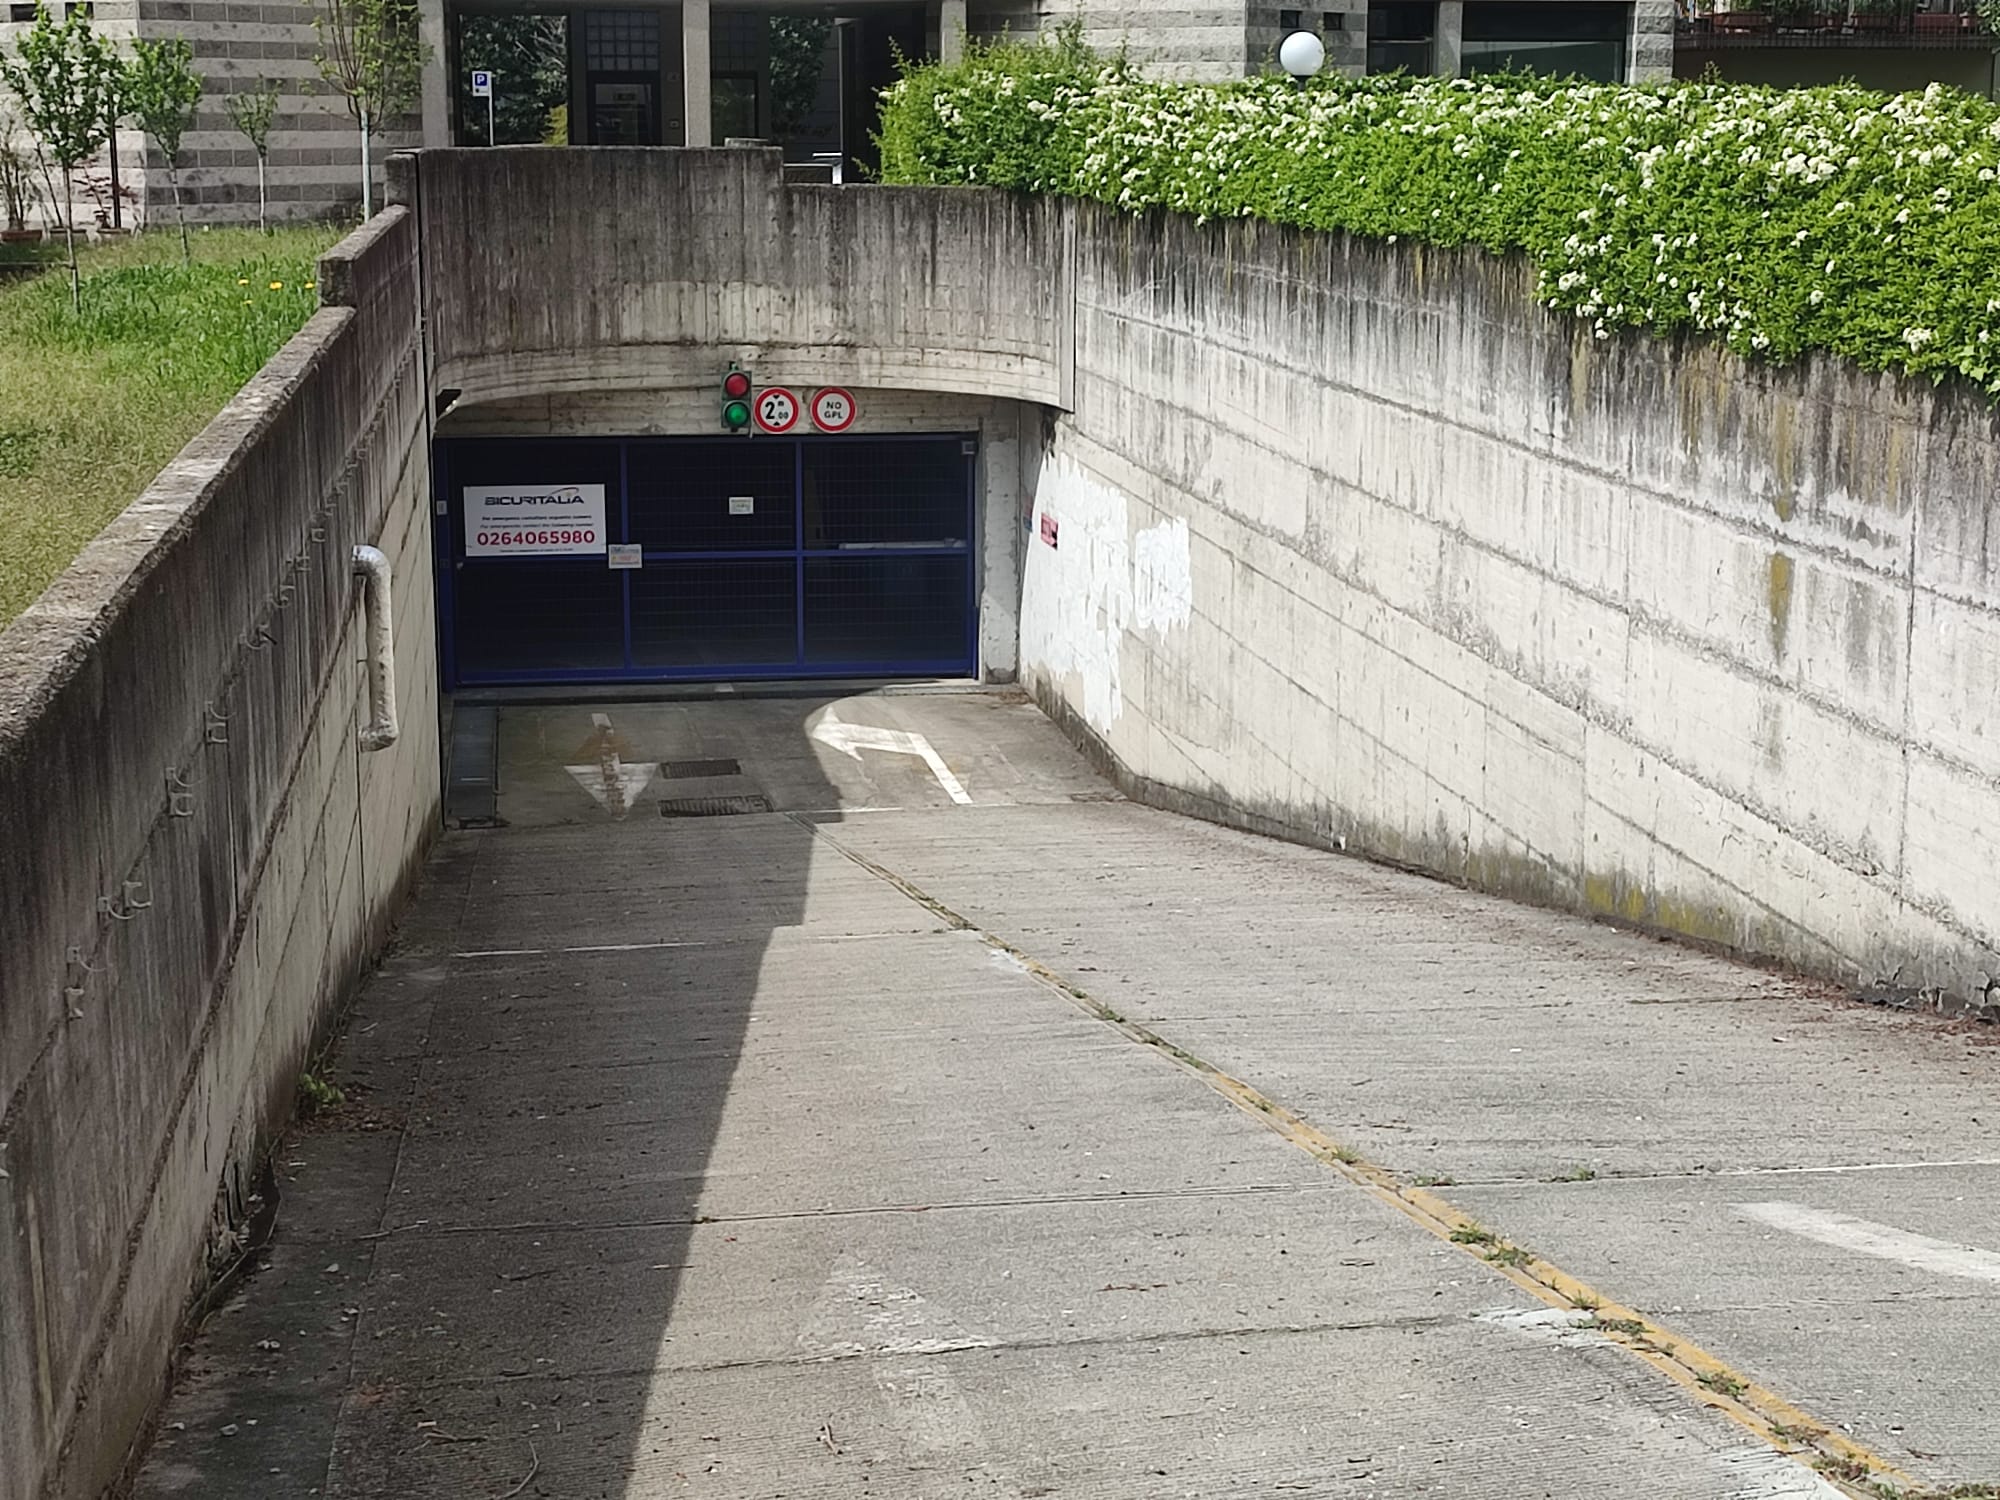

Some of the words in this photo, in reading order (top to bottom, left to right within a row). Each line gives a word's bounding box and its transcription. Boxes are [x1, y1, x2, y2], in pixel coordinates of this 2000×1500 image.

[477, 75, 485, 84] P
[765, 401, 775, 419] 2
[824, 411, 843, 419] GPL
[477, 530, 595, 546] 0264065980
